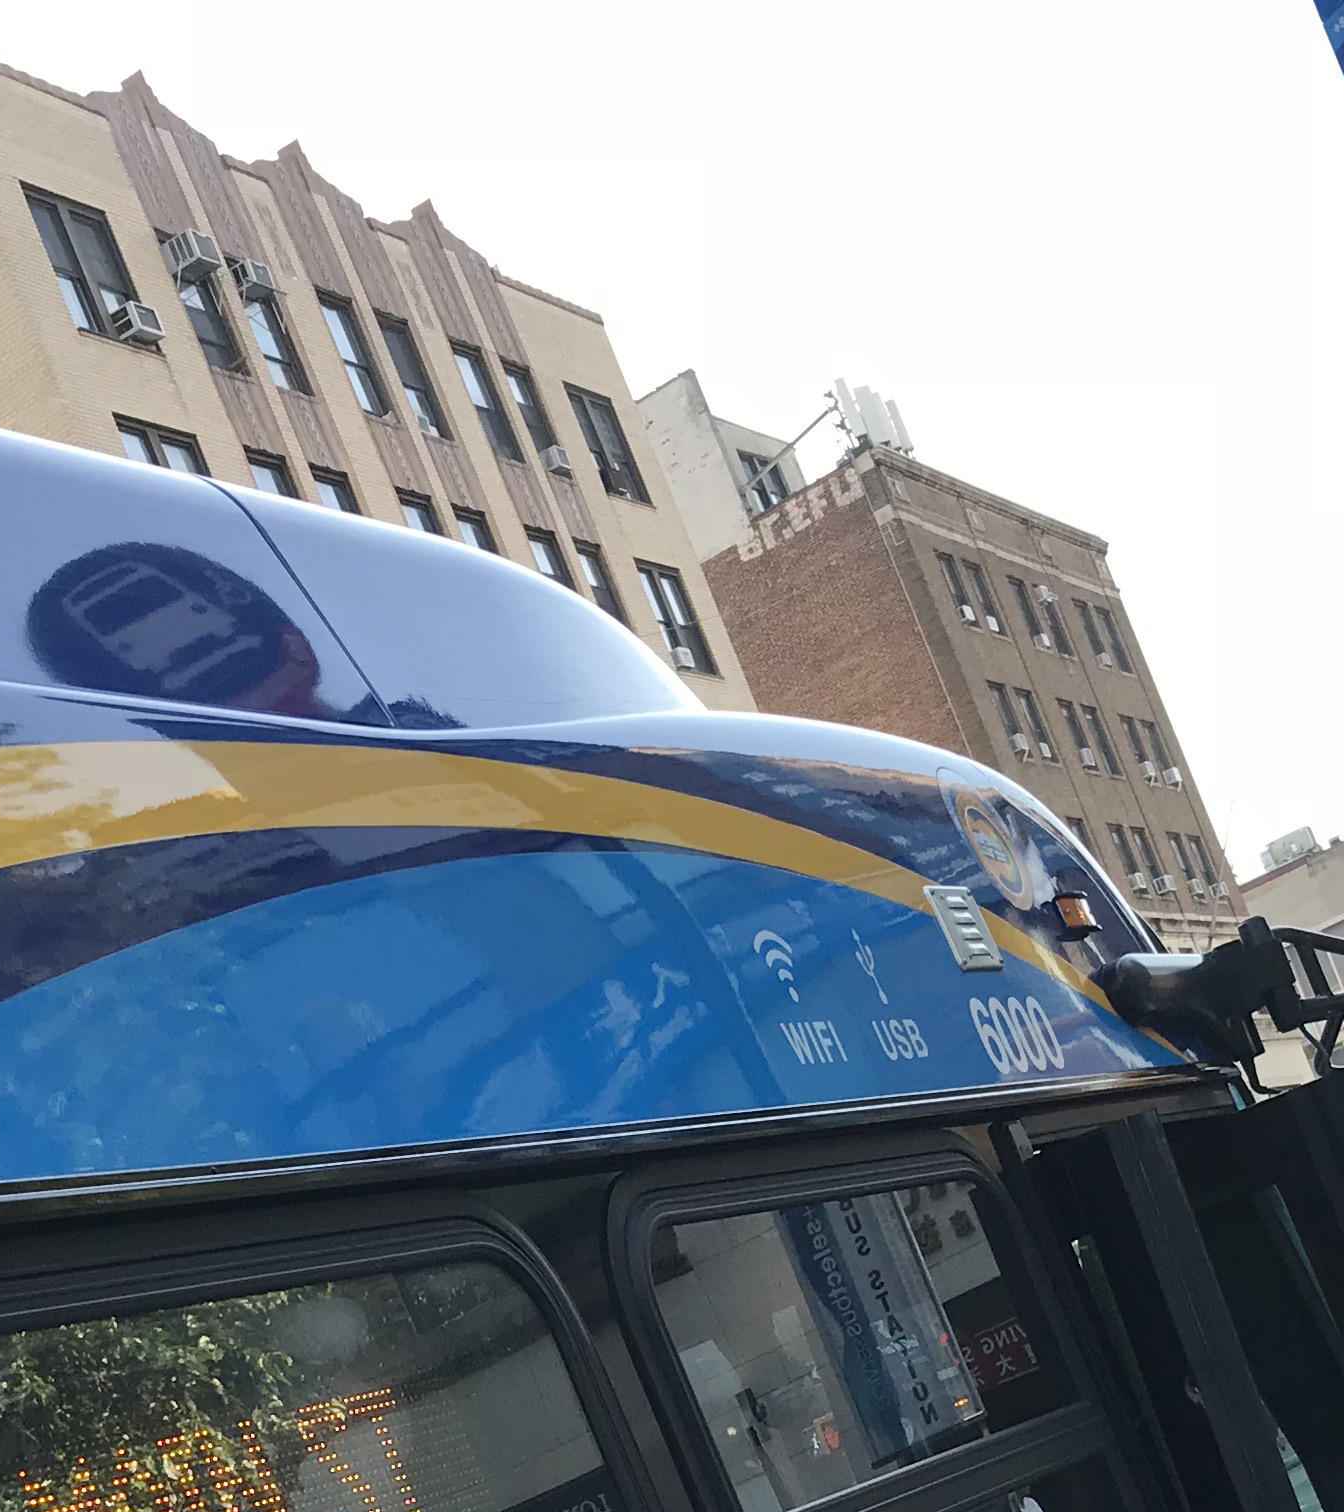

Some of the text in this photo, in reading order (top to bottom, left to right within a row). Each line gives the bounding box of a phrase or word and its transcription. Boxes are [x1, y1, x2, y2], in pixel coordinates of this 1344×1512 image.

[780, 1019, 849, 1066] WIFI
[871, 1018, 929, 1061] USB
[969, 996, 1065, 1075] 6000
